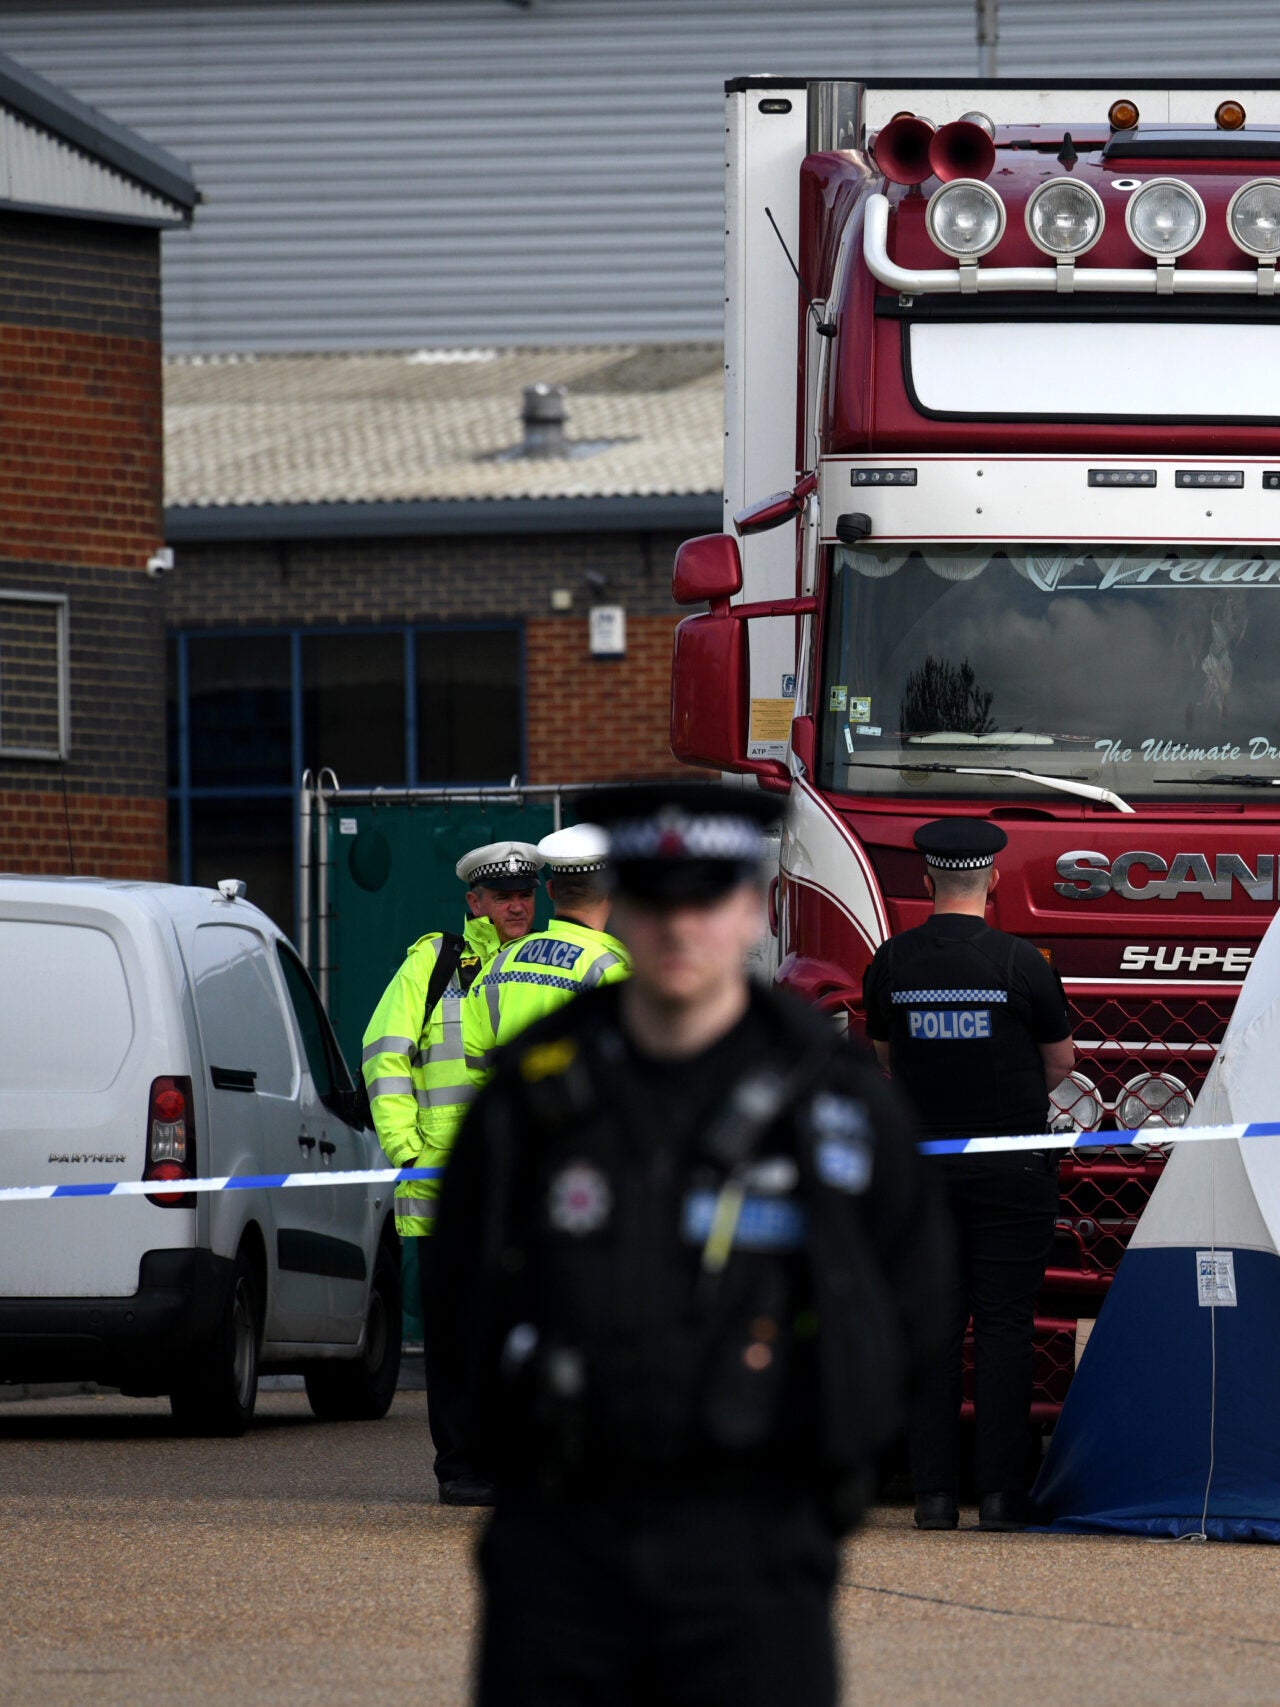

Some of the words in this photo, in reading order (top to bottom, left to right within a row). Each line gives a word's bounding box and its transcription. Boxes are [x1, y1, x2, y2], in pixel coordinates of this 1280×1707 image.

[751, 748, 767, 756] ATP
[1094, 739, 1132, 764] The
[1141, 738, 1241, 763] Ultimate
[516, 940, 581, 969] POLICE
[1120, 945, 1254, 972] SUPE
[910, 1011, 989, 1038] POLICE
[48, 1153, 127, 1164] PARTNER
